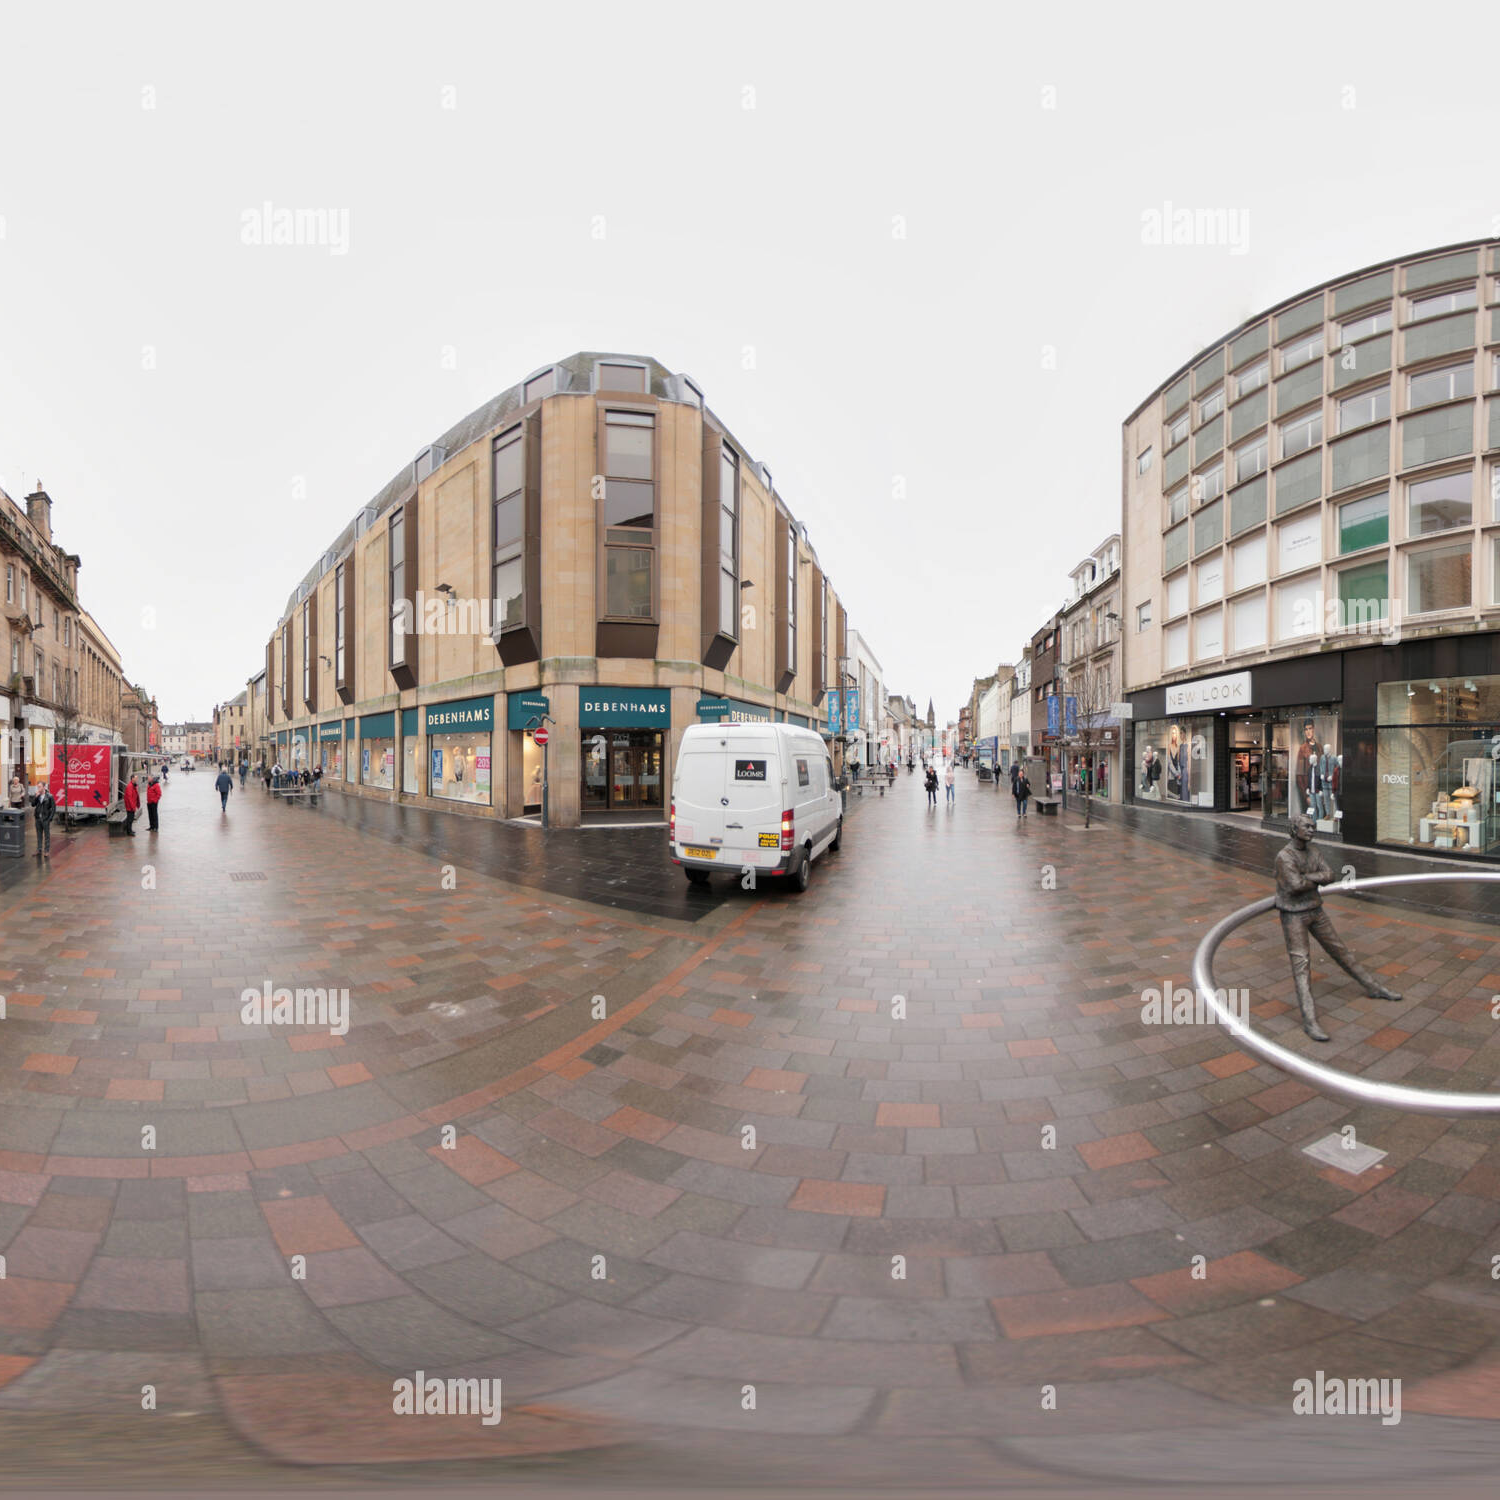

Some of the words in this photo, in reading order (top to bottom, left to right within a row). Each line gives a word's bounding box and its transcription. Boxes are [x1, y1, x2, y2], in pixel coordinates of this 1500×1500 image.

[1169, 690, 1195, 706] NEW
[1203, 683, 1242, 701] LOOK
[584, 702, 666, 713] DEBENHAMS
[428, 708, 490, 725] DEBENHAMS
[1382, 774, 1409, 785] next
